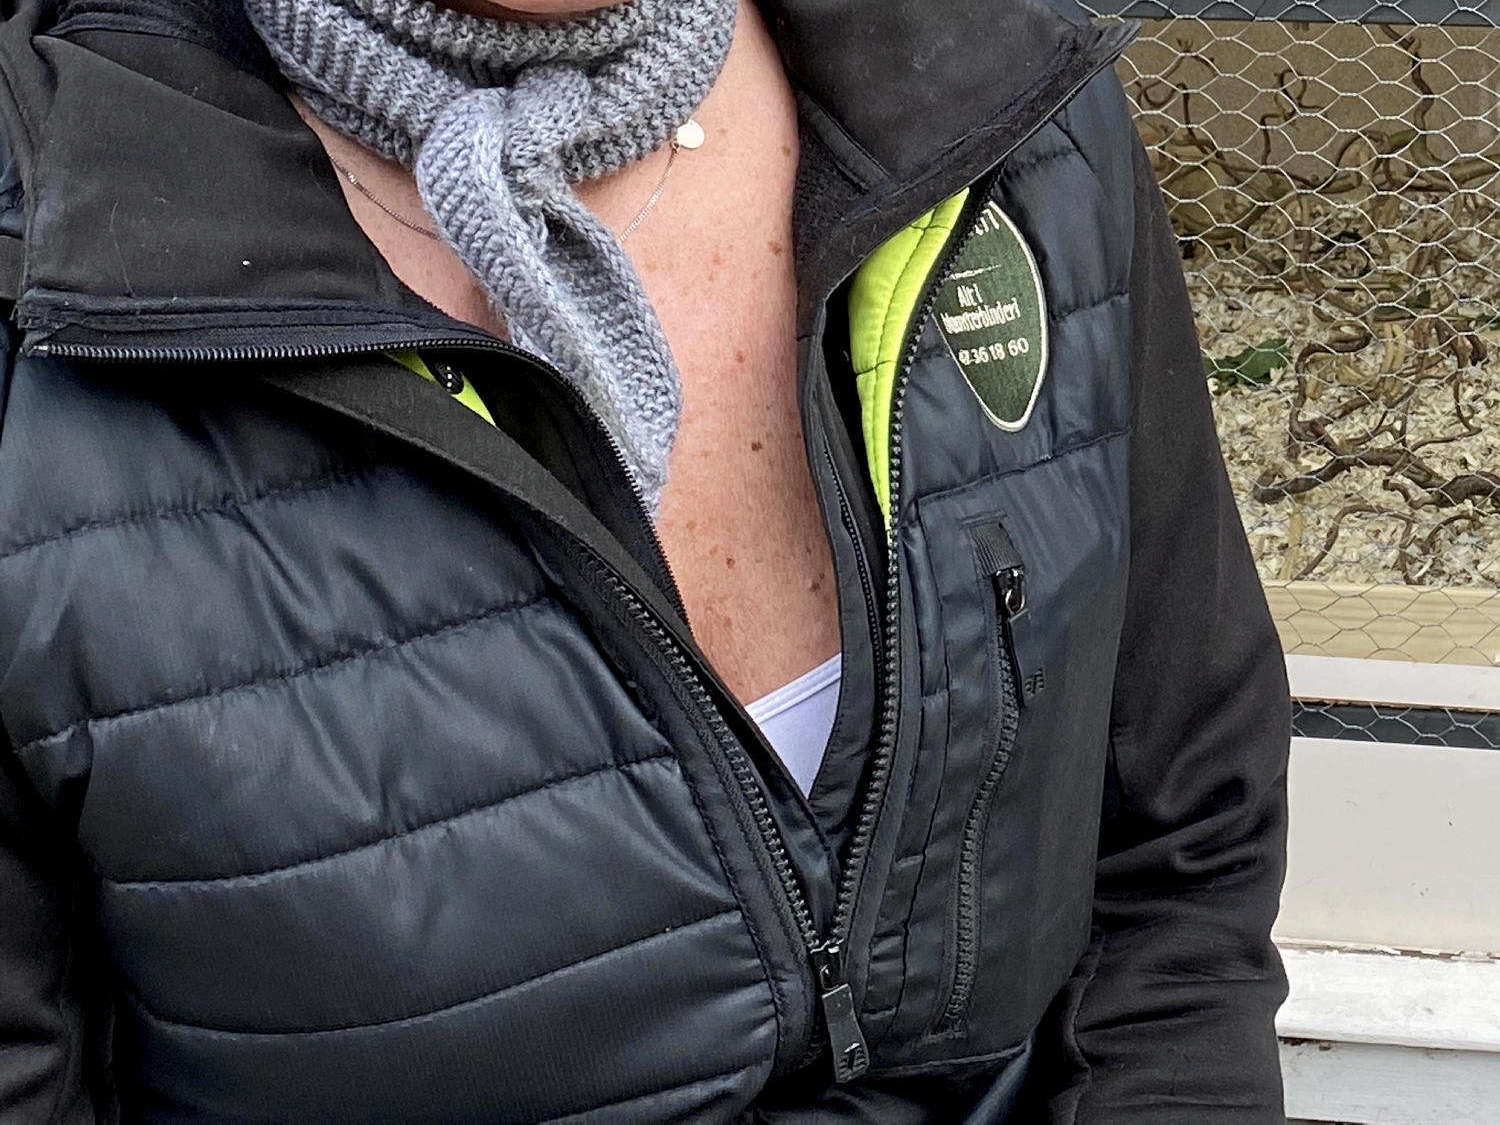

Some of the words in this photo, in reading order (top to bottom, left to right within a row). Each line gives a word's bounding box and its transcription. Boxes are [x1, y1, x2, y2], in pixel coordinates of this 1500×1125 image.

[957, 284, 977, 307] Alt
[971, 346, 989, 364] 36
[989, 342, 1005, 360] 18
[1008, 337, 1029, 356] 60
